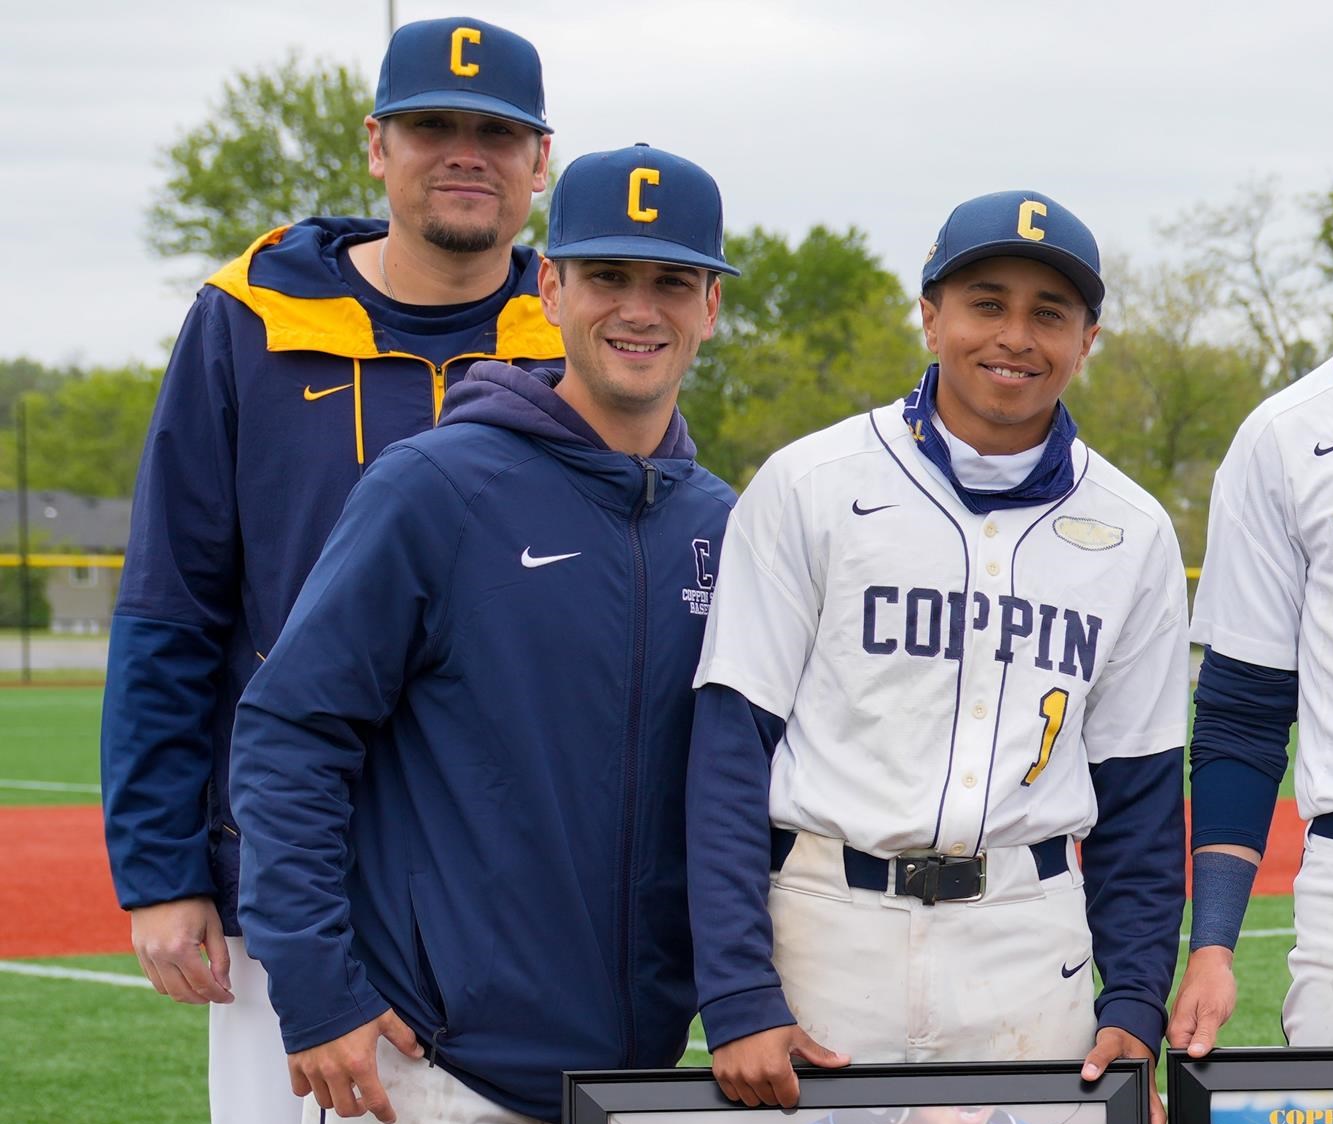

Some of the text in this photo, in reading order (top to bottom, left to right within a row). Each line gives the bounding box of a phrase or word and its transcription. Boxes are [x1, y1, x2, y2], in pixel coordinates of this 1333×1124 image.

[450, 28, 481, 77] C
[627, 168, 660, 223] C
[1017, 201, 1047, 241] C
[692, 538, 714, 589] C
[690, 602, 711, 614] BASE
[862, 585, 1103, 682] COPPIN
[1021, 687, 1069, 787] 1
